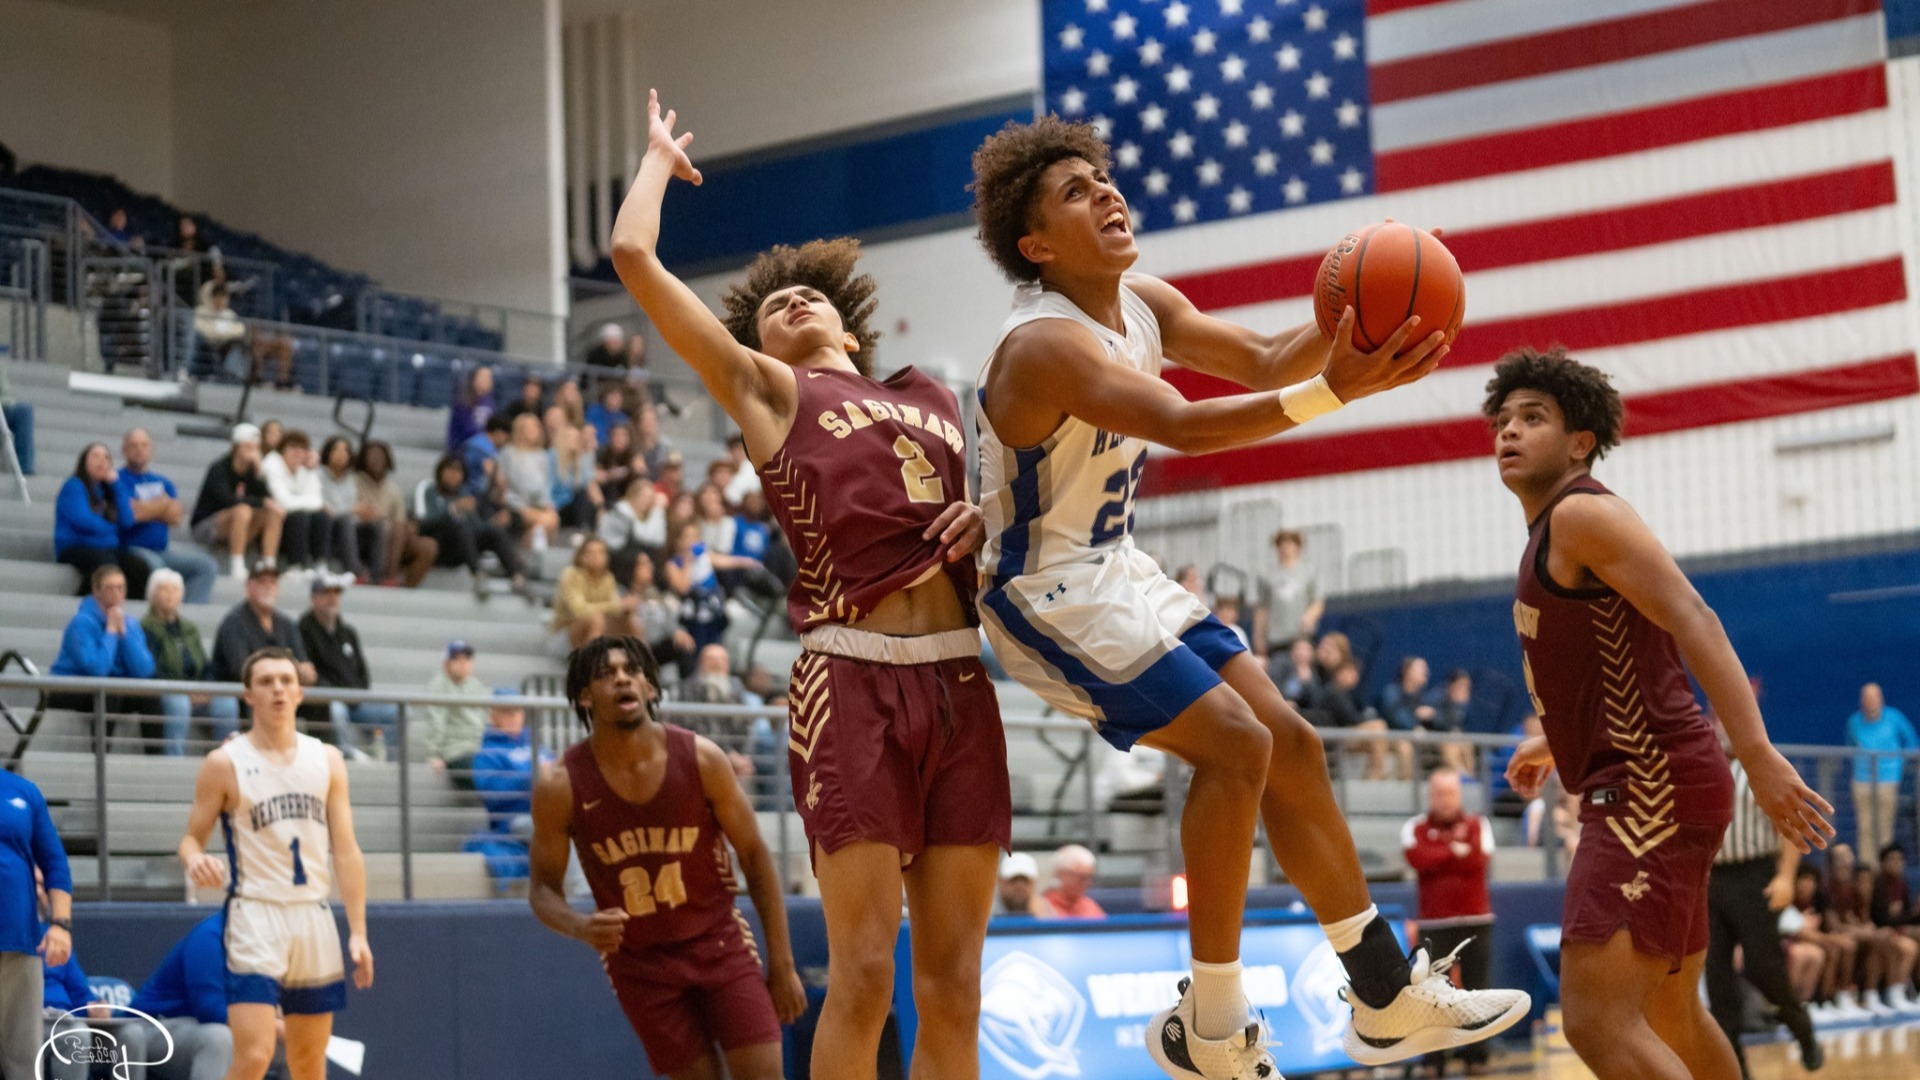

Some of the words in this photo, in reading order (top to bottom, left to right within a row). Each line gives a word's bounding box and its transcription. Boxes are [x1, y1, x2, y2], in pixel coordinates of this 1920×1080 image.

[818, 399, 964, 455] SAGINAW
[892, 434, 945, 504] 2
[289, 836, 308, 886] 1
[591, 826, 699, 866] SAGINAW
[619, 861, 688, 917] 24
